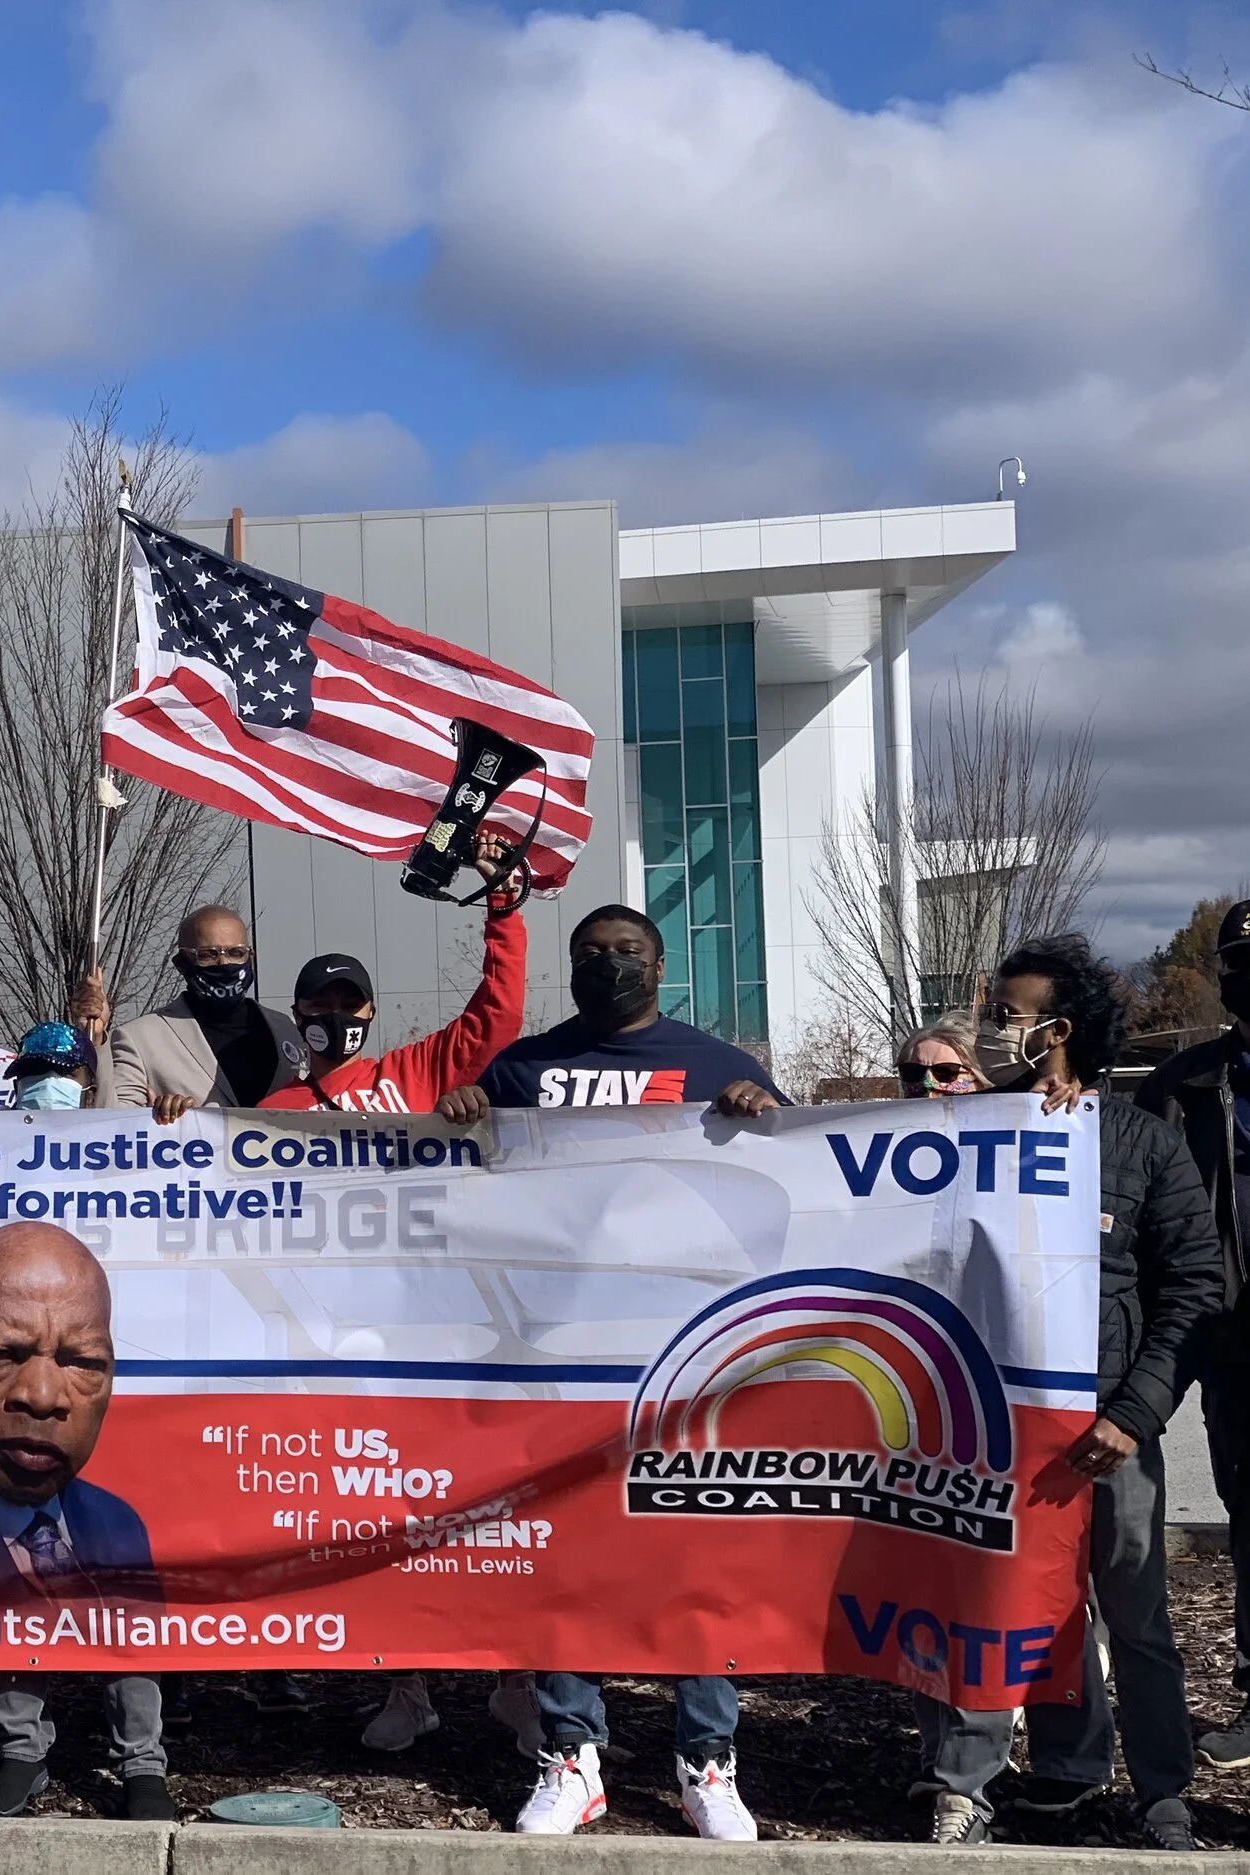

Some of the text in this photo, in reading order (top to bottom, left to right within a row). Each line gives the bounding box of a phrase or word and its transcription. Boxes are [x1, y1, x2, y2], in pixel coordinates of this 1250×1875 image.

[538, 1067, 654, 1108] STAY
[16, 1131, 214, 1171] Justice
[231, 1129, 483, 1169] Coalition
[825, 1130, 1070, 1197] VOTE
[156, 1184, 448, 1255] BRIDGE
[262, 1429, 323, 1457] not
[334, 1428, 399, 1466] US,
[237, 1462, 454, 1499] then WHO?
[332, 1515, 394, 1541] not
[403, 1520, 553, 1549] WHEN?
[651, 1489, 984, 1539] COALITION
[467, 1555, 534, 1575] Lewis
[837, 1593, 1055, 1688] VOTE
